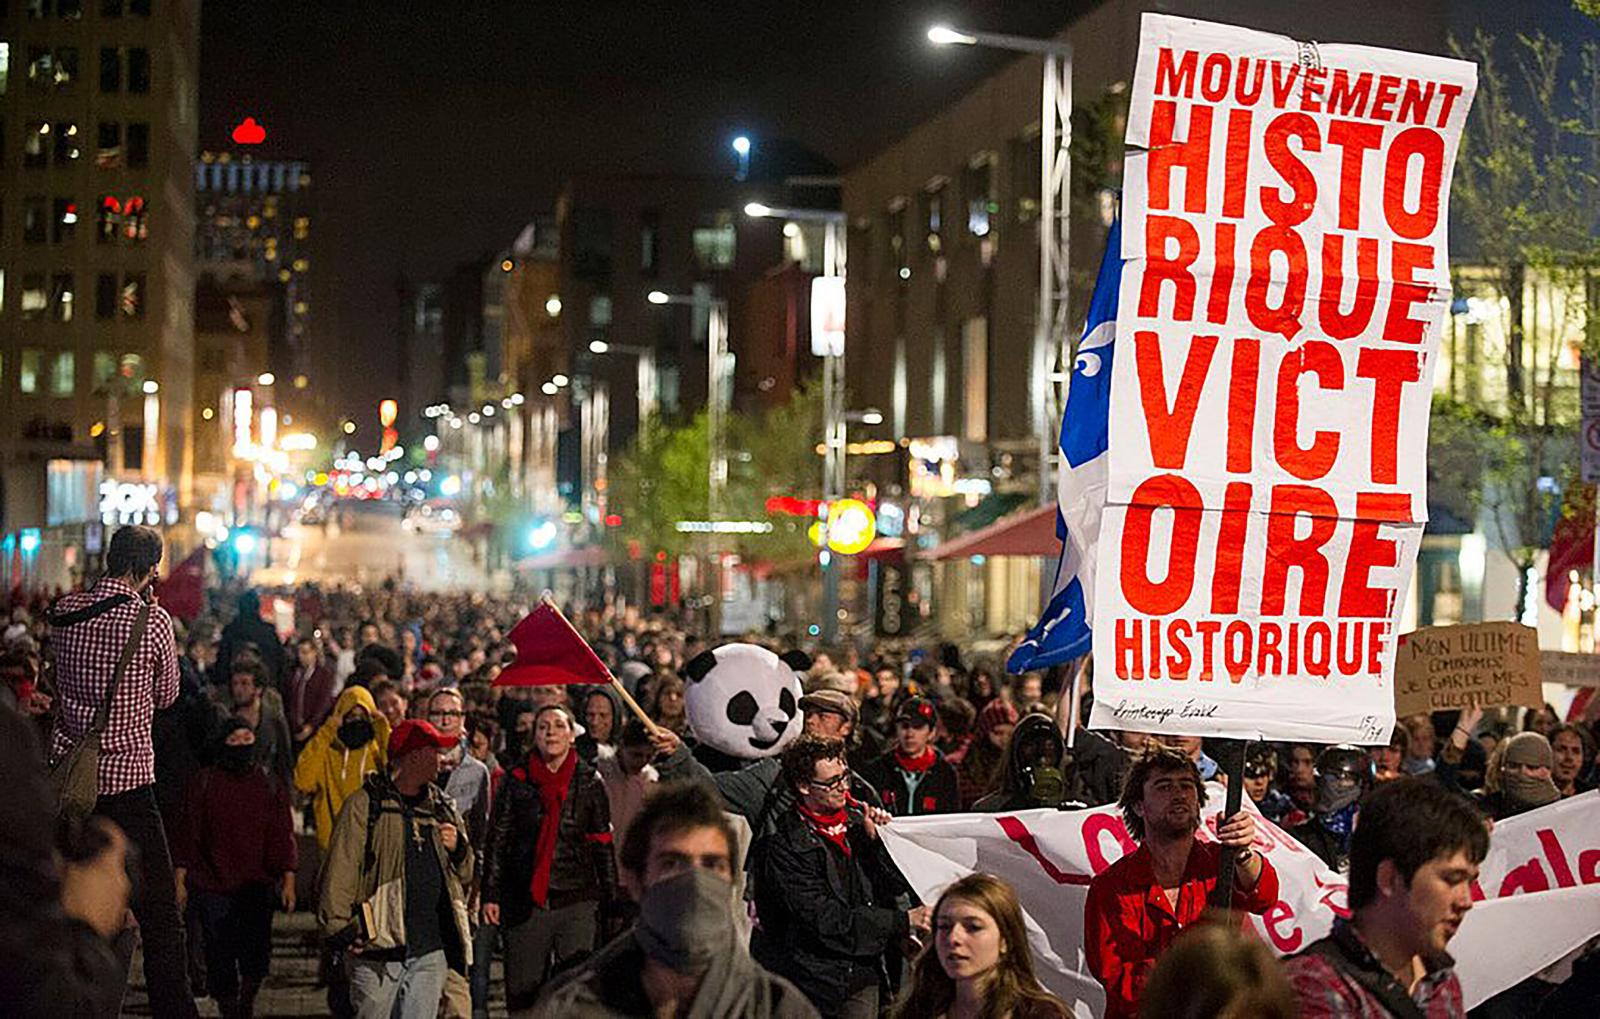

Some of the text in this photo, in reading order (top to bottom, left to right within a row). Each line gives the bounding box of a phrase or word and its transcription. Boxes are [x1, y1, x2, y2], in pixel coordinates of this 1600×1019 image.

[1154, 47, 1463, 129] MOUVEMENT
[1147, 100, 1445, 240] HISTO
[1137, 214, 1436, 345] RIQUE
[1134, 331, 1424, 485] VICT
[1119, 474, 1414, 619] OIRE
[1114, 618, 1388, 684] HISTORIQUE
